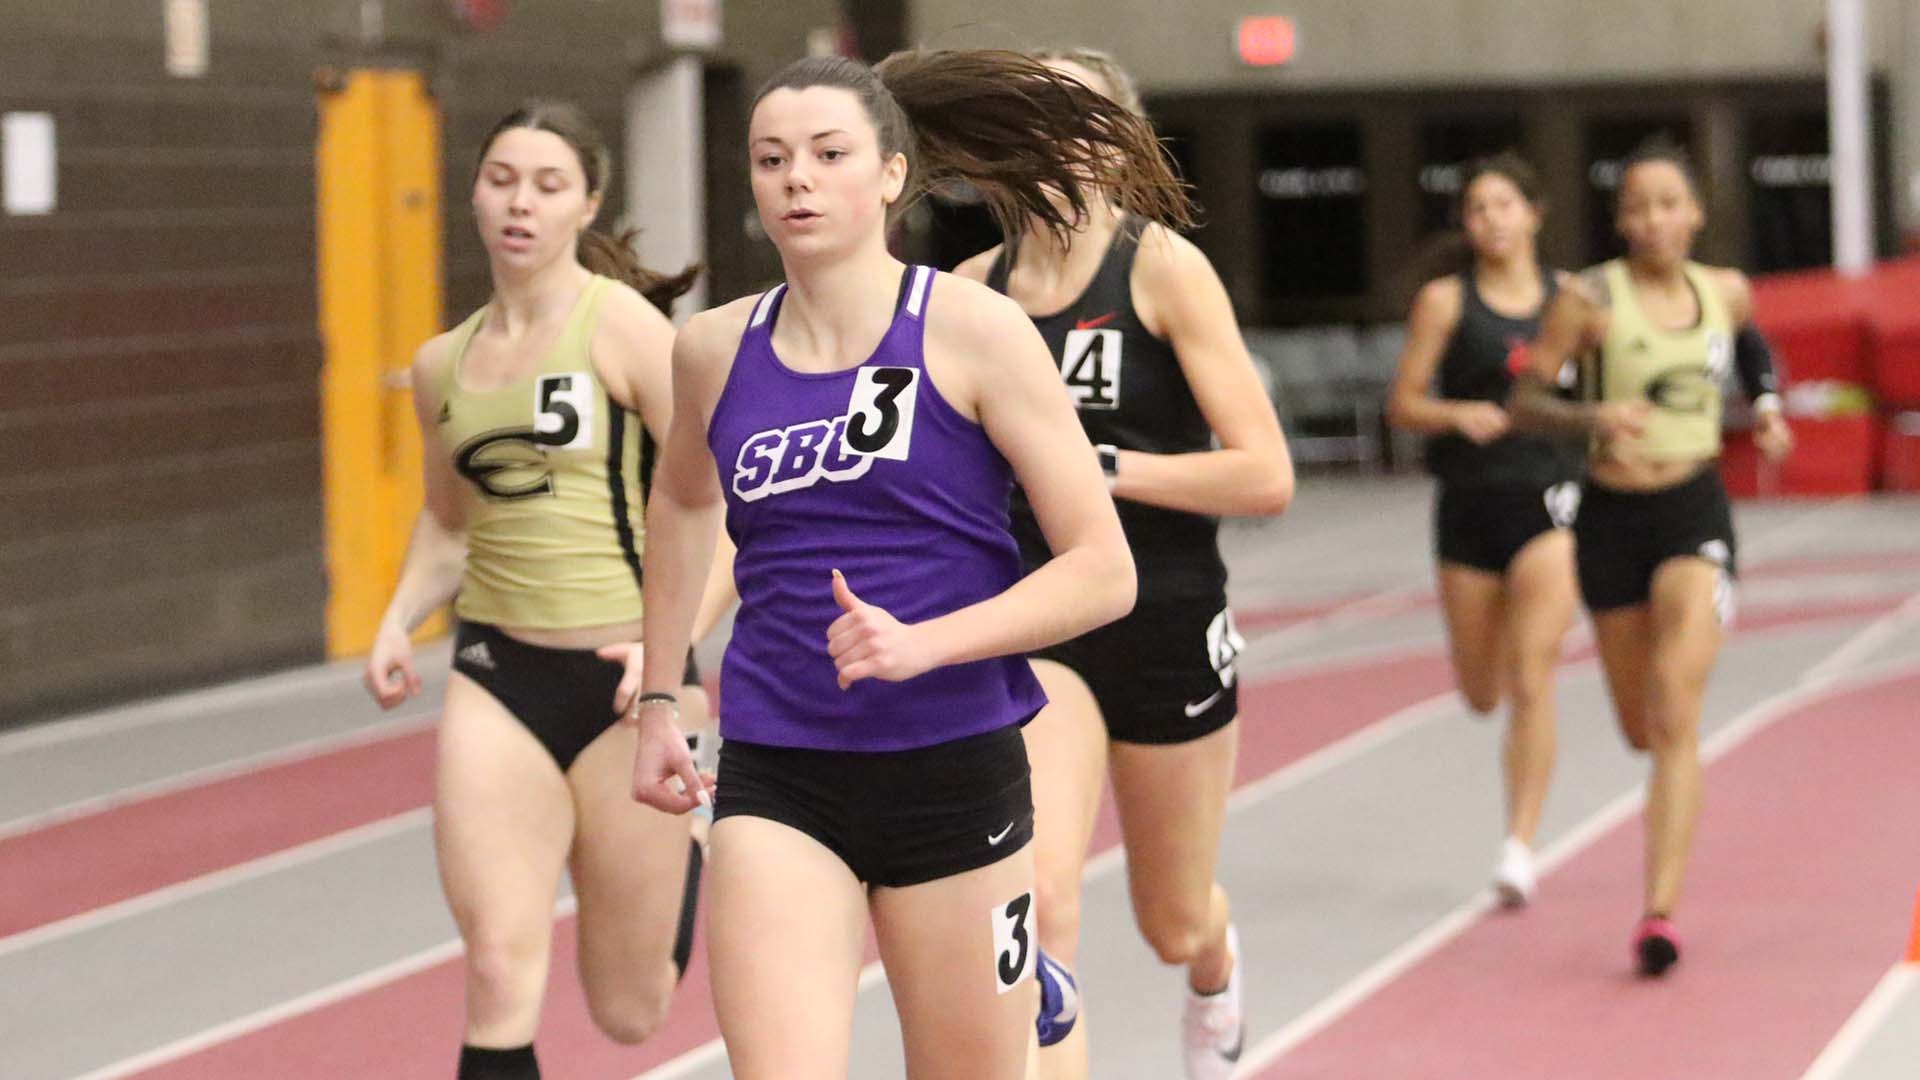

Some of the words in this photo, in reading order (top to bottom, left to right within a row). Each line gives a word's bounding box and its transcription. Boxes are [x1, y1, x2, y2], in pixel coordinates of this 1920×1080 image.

[1065, 333, 1115, 405] 4
[540, 376, 579, 446] 5
[846, 367, 914, 453] 3
[998, 892, 1031, 986] 3
